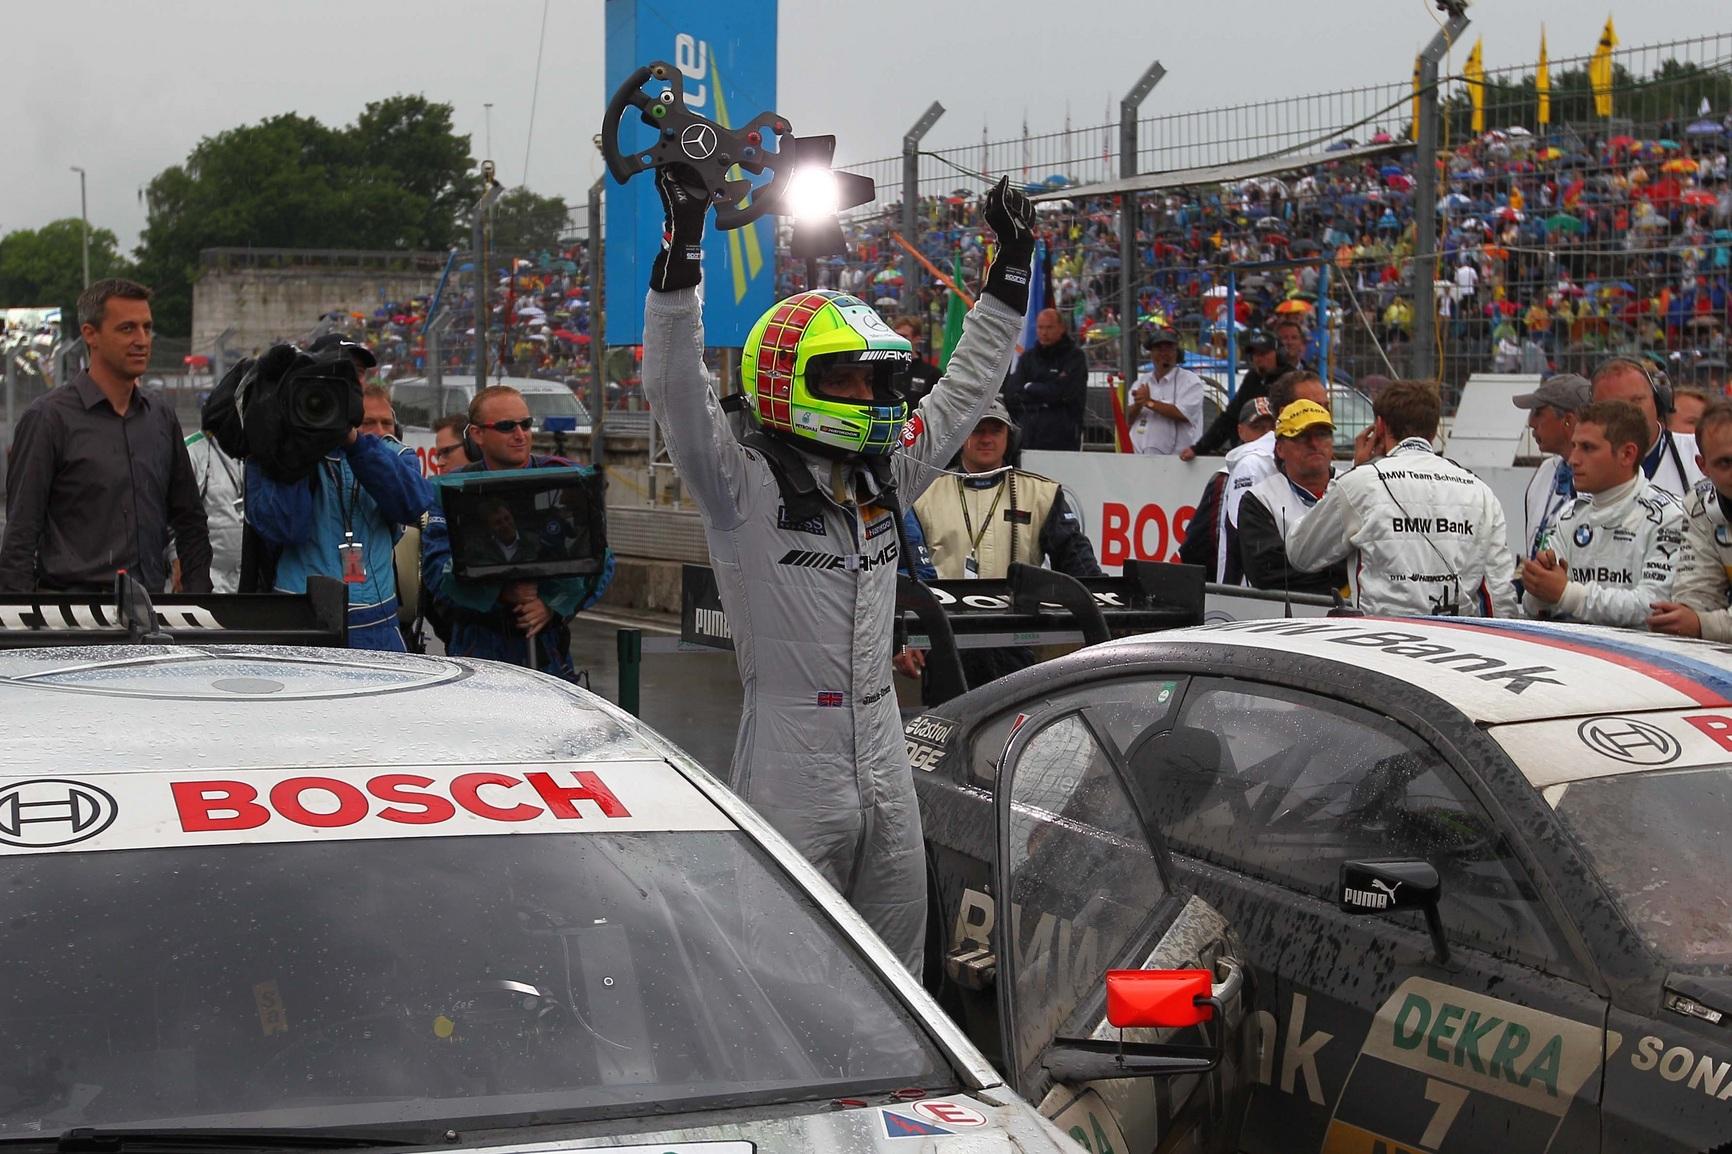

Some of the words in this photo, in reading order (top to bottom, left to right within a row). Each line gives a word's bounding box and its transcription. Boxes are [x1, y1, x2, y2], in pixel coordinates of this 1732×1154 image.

[1378, 470, 1406, 481] BMW
[1407, 470, 1433, 481] Team
[1434, 472, 1475, 486] Schnitzer
[1101, 502, 1198, 568] BOS
[1392, 517, 1433, 534] BMW
[1436, 517, 1474, 536] Bank
[1597, 567, 1633, 584] Bank
[695, 607, 732, 639] PUMA
[1324, 631, 1567, 696] Bank
[914, 717, 954, 744] Castrol
[170, 770, 632, 834] BOSCH
[1344, 887, 1388, 909] PUMA
[1393, 992, 1563, 1098] DEKRA
[921, 1104, 979, 1123] E
